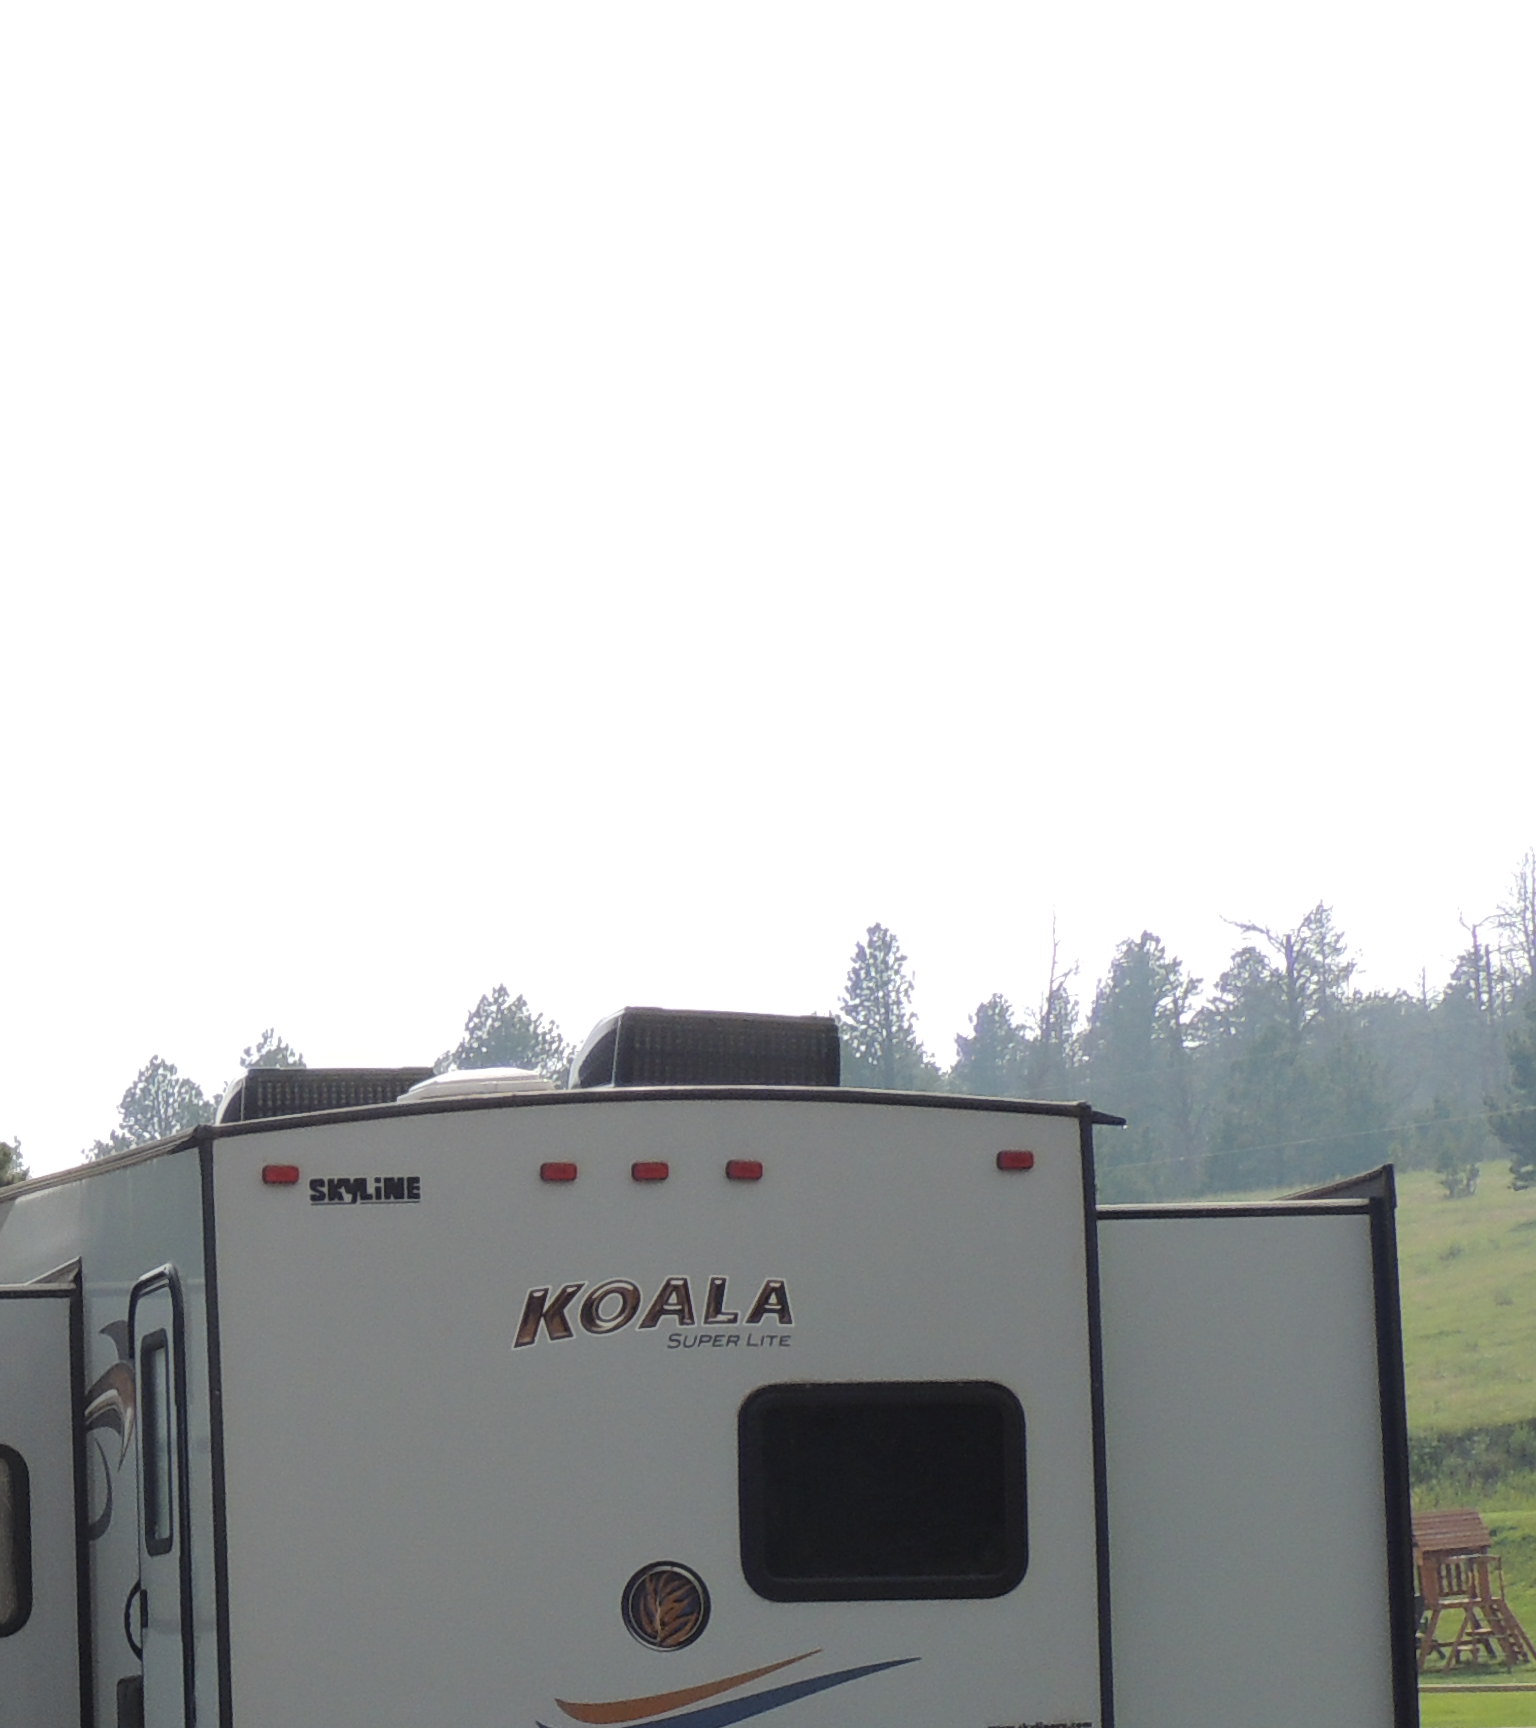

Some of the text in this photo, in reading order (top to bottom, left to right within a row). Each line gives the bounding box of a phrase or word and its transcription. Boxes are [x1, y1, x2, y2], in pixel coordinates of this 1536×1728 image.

[512, 1275, 794, 1349] KOALA
[666, 1332, 792, 1349] SUPER LITE
